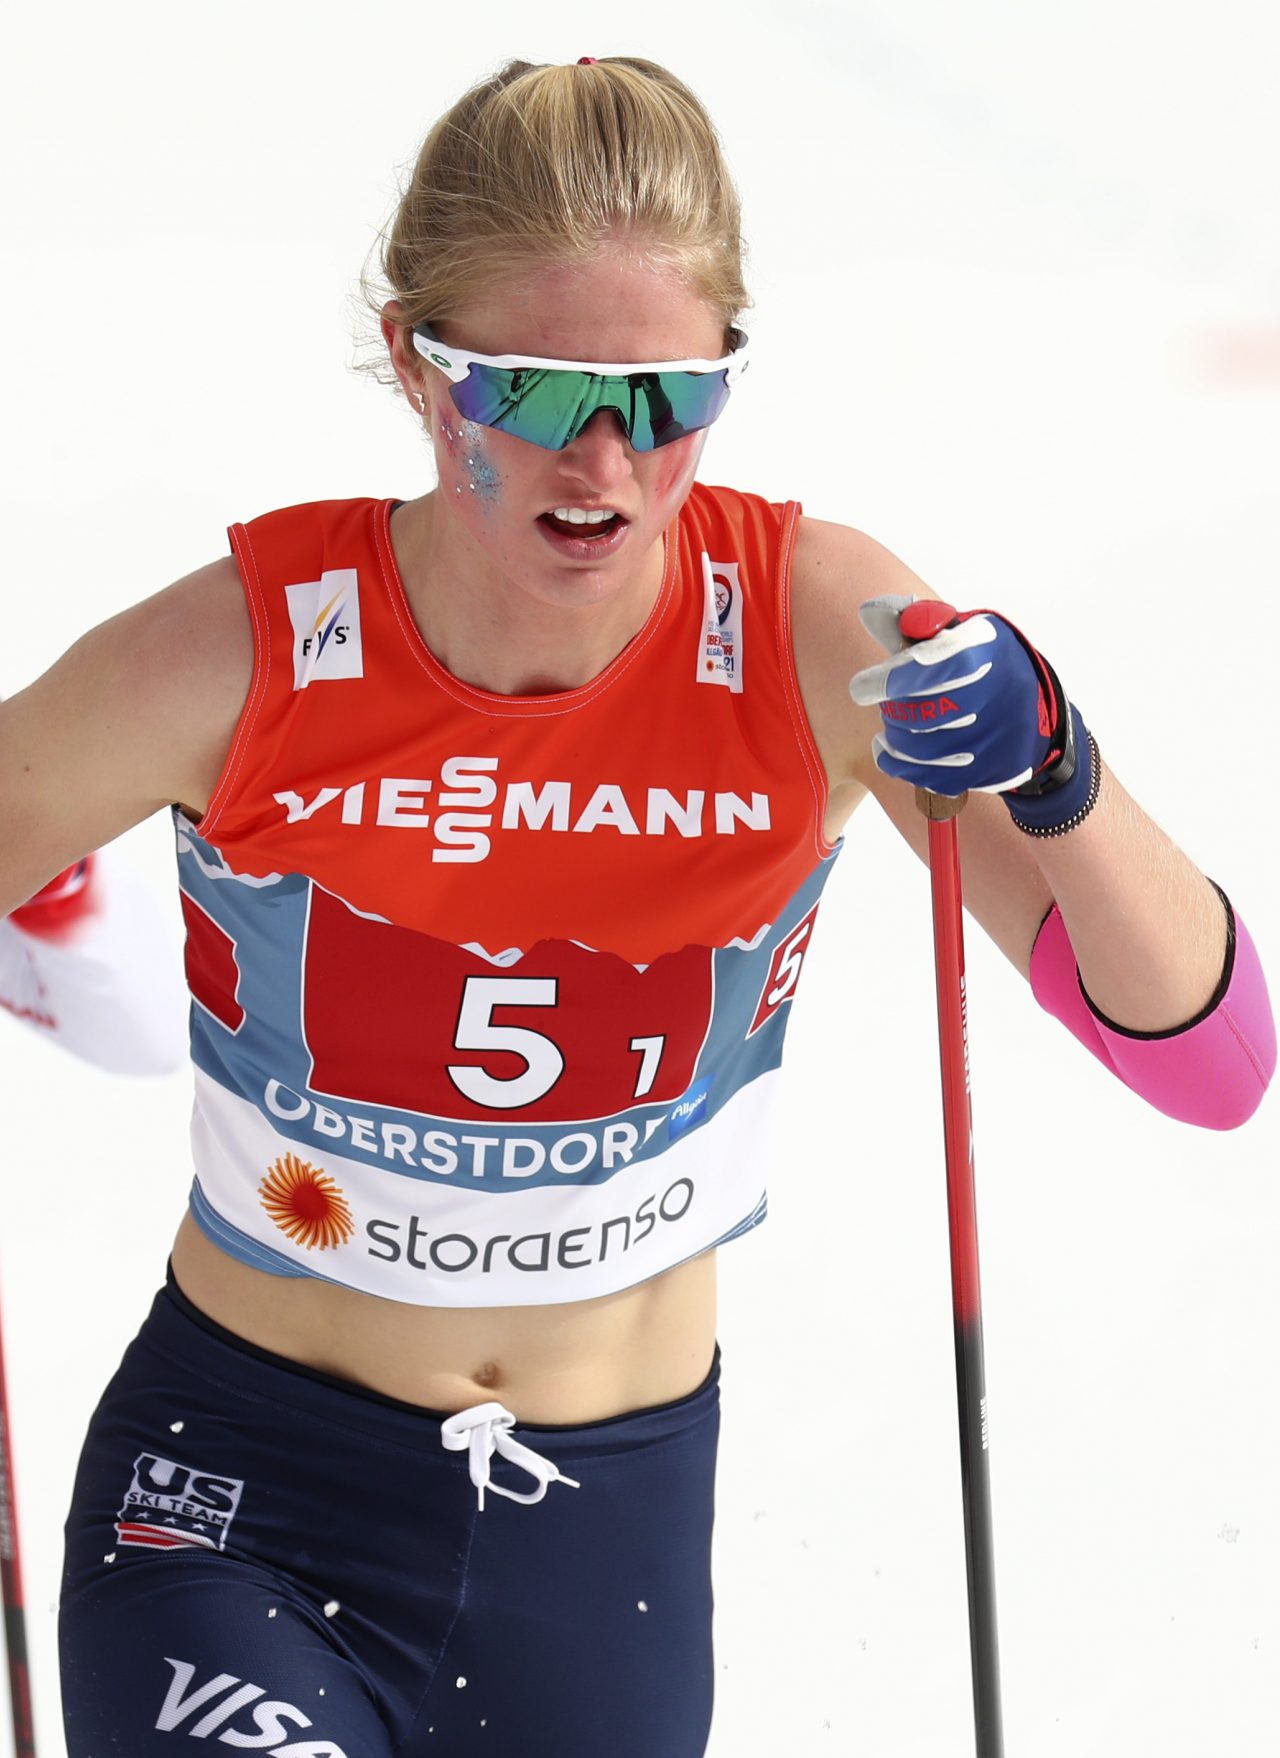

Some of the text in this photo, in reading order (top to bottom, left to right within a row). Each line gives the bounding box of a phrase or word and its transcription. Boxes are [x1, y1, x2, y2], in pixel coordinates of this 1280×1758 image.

[880, 696, 960, 723] HESTRA
[272, 757, 771, 863] VIESSMANN
[766, 922, 809, 1006] 5
[445, 975, 666, 1109] 5 1
[366, 1177, 694, 1273] storaenso
[127, 1491, 228, 1525] SKI TEAM
[136, 1456, 238, 1513] US
